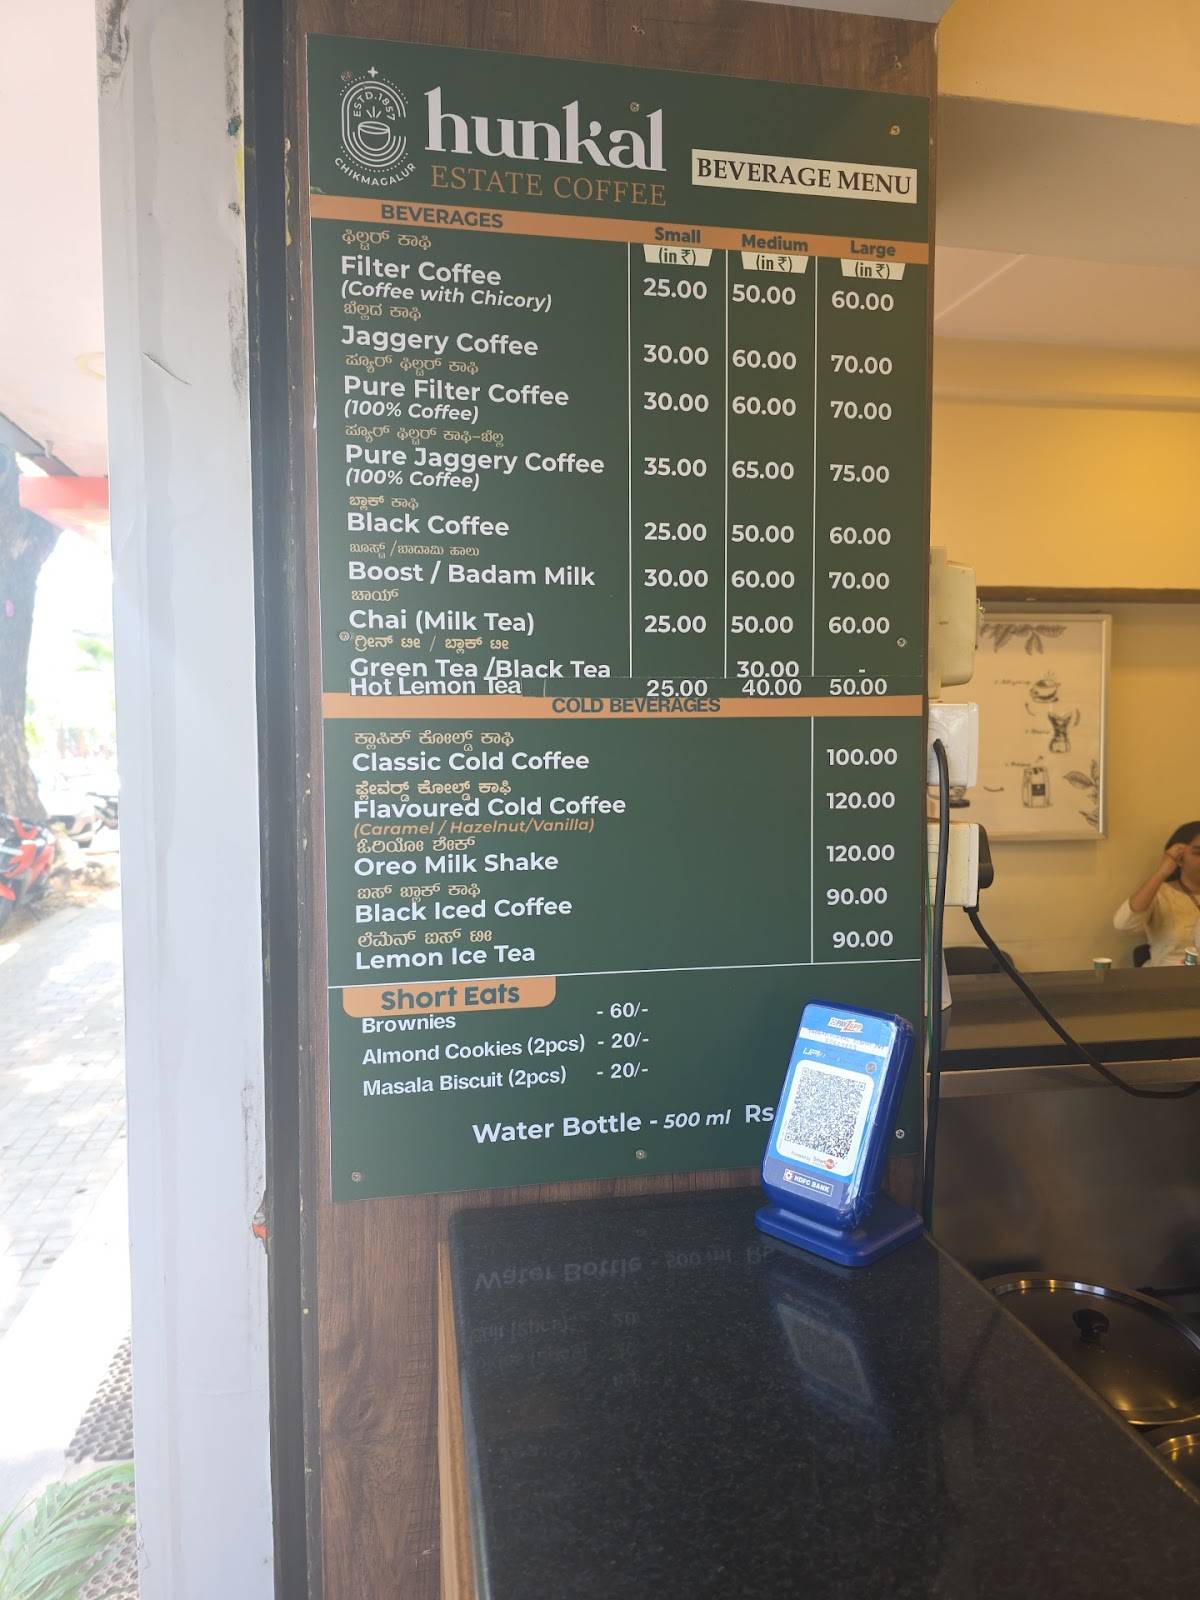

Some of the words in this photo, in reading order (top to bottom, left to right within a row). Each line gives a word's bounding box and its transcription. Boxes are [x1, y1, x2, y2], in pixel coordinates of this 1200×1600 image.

[335, 158, 416, 186] CHIKMAGALUR
[697, 158, 831, 188] BEVERAGE
[838, 170, 911, 194] MENU
[431, 165, 543, 196] ESTATE
[554, 176, 666, 206] COFFEE
[381, 204, 504, 228] BEVERAGES
[398, 234, 432, 250] ಕಾಫಿ
[655, 226, 700, 244] Small
[741, 234, 808, 252] Medium
[658, 246, 676, 265] (in
[850, 240, 896, 258] Large
[341, 254, 410, 279] Filter
[418, 260, 502, 286] Coffee
[756, 254, 774, 271] (in
[854, 260, 872, 278] (in
[340, 279, 414, 302] (Coffee
[420, 284, 464, 304] with
[470, 290, 552, 313] Chicory)
[643, 277, 708, 300] 25.00
[732, 284, 796, 305] 50.00
[832, 290, 894, 312] 60.00
[390, 306, 422, 322] ಕಾಫಿ
[341, 324, 449, 354] Jaggery
[456, 332, 539, 356] Coffee
[643, 344, 710, 366] 30.00
[732, 350, 797, 370] 60.00
[830, 354, 893, 375] 70.00
[448, 361, 479, 375] ಕಾಫಿ
[344, 375, 406, 397] Pure
[414, 378, 480, 402] Filter
[488, 384, 569, 406] Coffee
[344, 399, 402, 418] (100%
[408, 403, 479, 424] Coffee)
[643, 392, 710, 412] 30.00
[732, 396, 797, 416] 60.00
[830, 400, 892, 420] 70.00
[346, 444, 407, 466] Pure
[414, 447, 518, 474] Jaggery
[525, 452, 604, 474] Coffee
[644, 456, 707, 477] 35.00
[346, 468, 402, 486] (100%
[410, 470, 480, 492] Coffee)
[732, 460, 794, 480] 65.00
[829, 464, 890, 484] 75.00
[392, 496, 418, 510] ಕಾಫಿ
[347, 512, 420, 534] Black
[428, 514, 510, 536] Coffee
[644, 522, 707, 542] 25.00
[731, 524, 794, 544] 50.00
[829, 526, 892, 546] 60.00
[348, 561, 424, 582] Boost
[448, 564, 536, 584] Badam
[544, 566, 596, 586] Milk
[644, 568, 708, 588] 30.00
[731, 570, 795, 588] 60.00
[828, 572, 890, 590] 70.00
[352, 588, 400, 602] ಚಾಯ್
[349, 608, 406, 630] Chai
[416, 610, 477, 635] (Milk
[484, 612, 534, 636] Tea)
[644, 615, 707, 634] 25.00
[730, 616, 794, 634] 50.00
[828, 616, 890, 634] 60.00
[350, 658, 428, 678] Green
[434, 659, 478, 678] Tea
[486, 656, 564, 679] /Black
[570, 660, 611, 678] Tea
[736, 660, 800, 678] 30.00
[350, 677, 392, 696] Hot
[398, 678, 476, 696] Lemon
[486, 677, 522, 694] Tea
[646, 680, 708, 697] 25.00
[742, 678, 802, 696] 40.00
[829, 678, 888, 696] 50.00
[552, 698, 602, 713] COLD
[610, 696, 720, 713] BEVERAGES
[480, 731, 514, 746] ಕಾಫಿ
[352, 751, 440, 772] Classic
[448, 752, 504, 770] Cold
[512, 752, 590, 770] Coffee
[826, 748, 898, 766] 100.00
[354, 798, 480, 819] Flavoured
[488, 797, 542, 816] Cold
[550, 796, 626, 814] Coffee
[826, 792, 896, 810] 120.00
[354, 821, 434, 839] (Caramel
[450, 818, 594, 834] Hazelnut/Vanilla)
[826, 844, 895, 862] 120.00
[354, 856, 416, 876] Oreo
[425, 854, 477, 874] Milk
[484, 852, 558, 872] Shake
[448, 883, 480, 898] ಕಾಫಿ
[826, 888, 888, 906] 90.00
[356, 902, 426, 923] Black
[434, 899, 486, 920] Iced
[494, 898, 572, 918] Coffee
[832, 930, 894, 948] 90.00
[356, 949, 442, 970] Lemon
[451, 946, 487, 966] Ice
[494, 944, 535, 964] Tea
[381, 986, 458, 1010] Short
[464, 983, 520, 1006] Eats
[362, 1014, 456, 1034] Brownies
[610, 1002, 648, 1018] 60/-
[362, 1045, 440, 1065] Almond
[445, 1040, 522, 1060] Cookies
[528, 1034, 585, 1056] (2pcs)
[611, 1032, 649, 1049] 20/-
[363, 1078, 434, 1097] Masala
[440, 1071, 503, 1091] Biscuit
[508, 1066, 566, 1088] (2pcs)
[610, 1062, 648, 1080] 20/-
[472, 1120, 554, 1144] Water
[562, 1112, 642, 1138] Bottle
[663, 1112, 700, 1130] 500
[705, 1109, 730, 1126] ml
